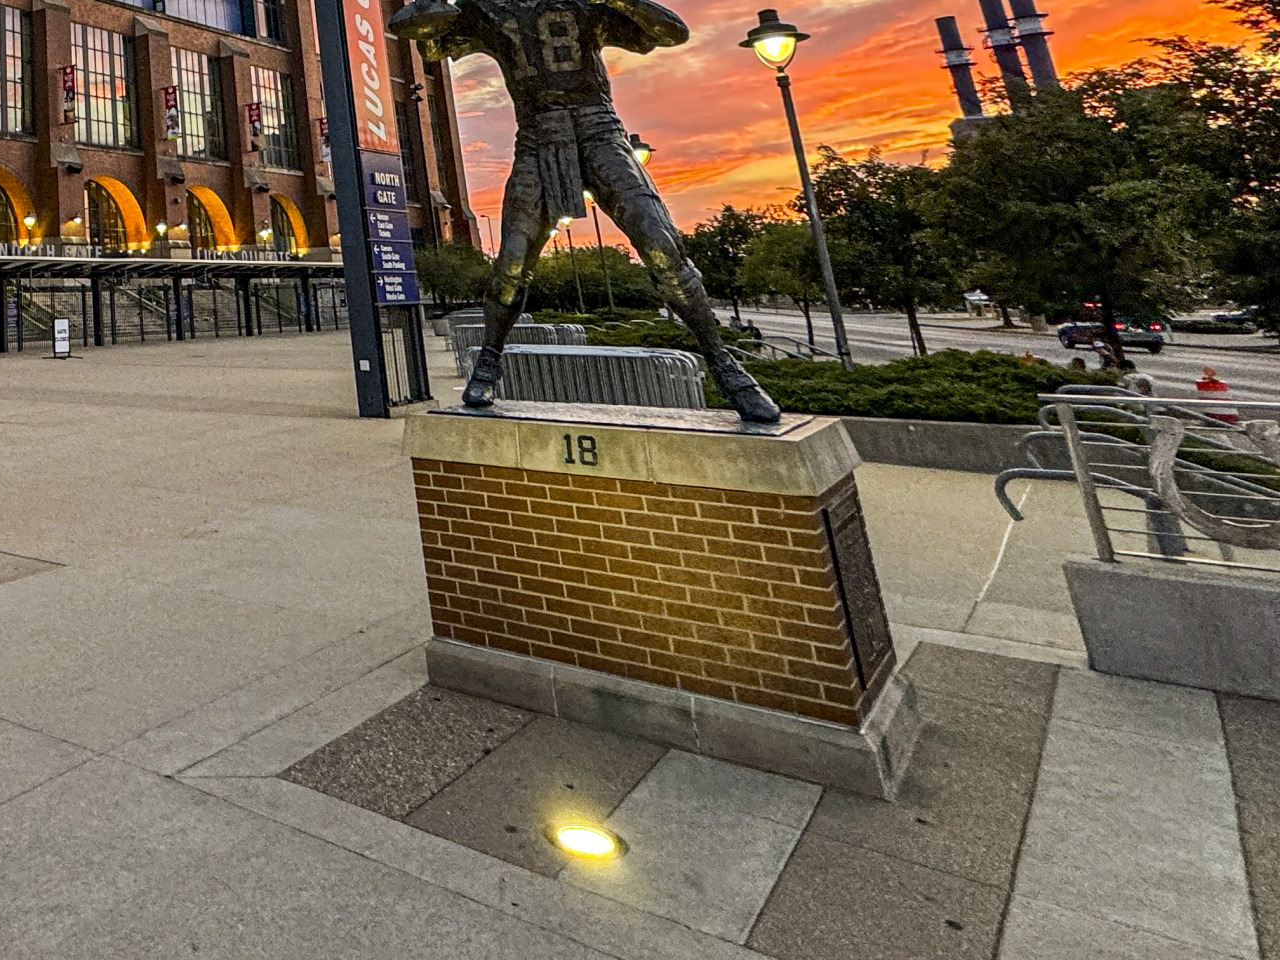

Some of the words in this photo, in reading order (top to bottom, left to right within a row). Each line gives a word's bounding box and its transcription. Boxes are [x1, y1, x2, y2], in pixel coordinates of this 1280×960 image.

[503, 10, 582, 81] 18
[355, 13, 388, 142] LUCAS
[374, 171, 400, 188] NORTH
[377, 190, 397, 205] GATE
[62, 244, 103, 259] GATE
[563, 433, 598, 467] 18
